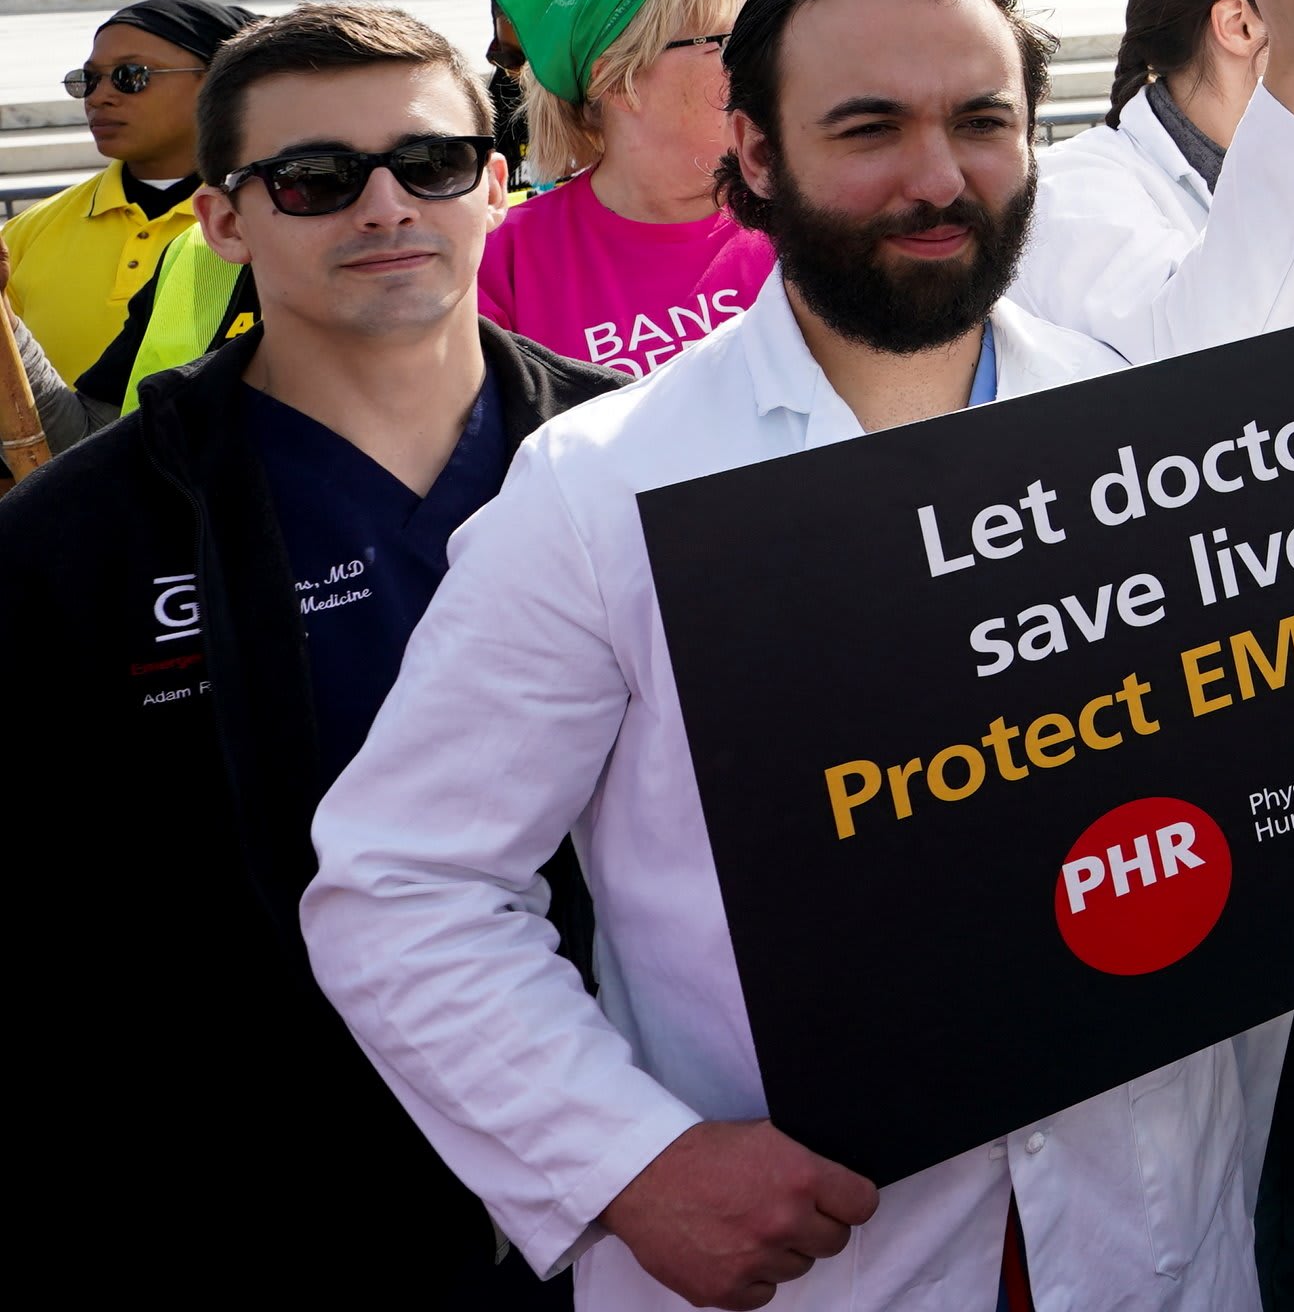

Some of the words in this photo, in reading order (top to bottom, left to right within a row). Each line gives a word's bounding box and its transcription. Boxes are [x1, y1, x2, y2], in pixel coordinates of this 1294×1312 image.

[584, 289, 746, 363] BANS
[324, 560, 364, 585] MD
[917, 484, 1065, 578] Let
[300, 587, 373, 615] Medicine
[968, 570, 1166, 678] save
[143, 685, 192, 706] Adam
[824, 670, 1161, 841] Protect
[1061, 821, 1206, 915] PHR
